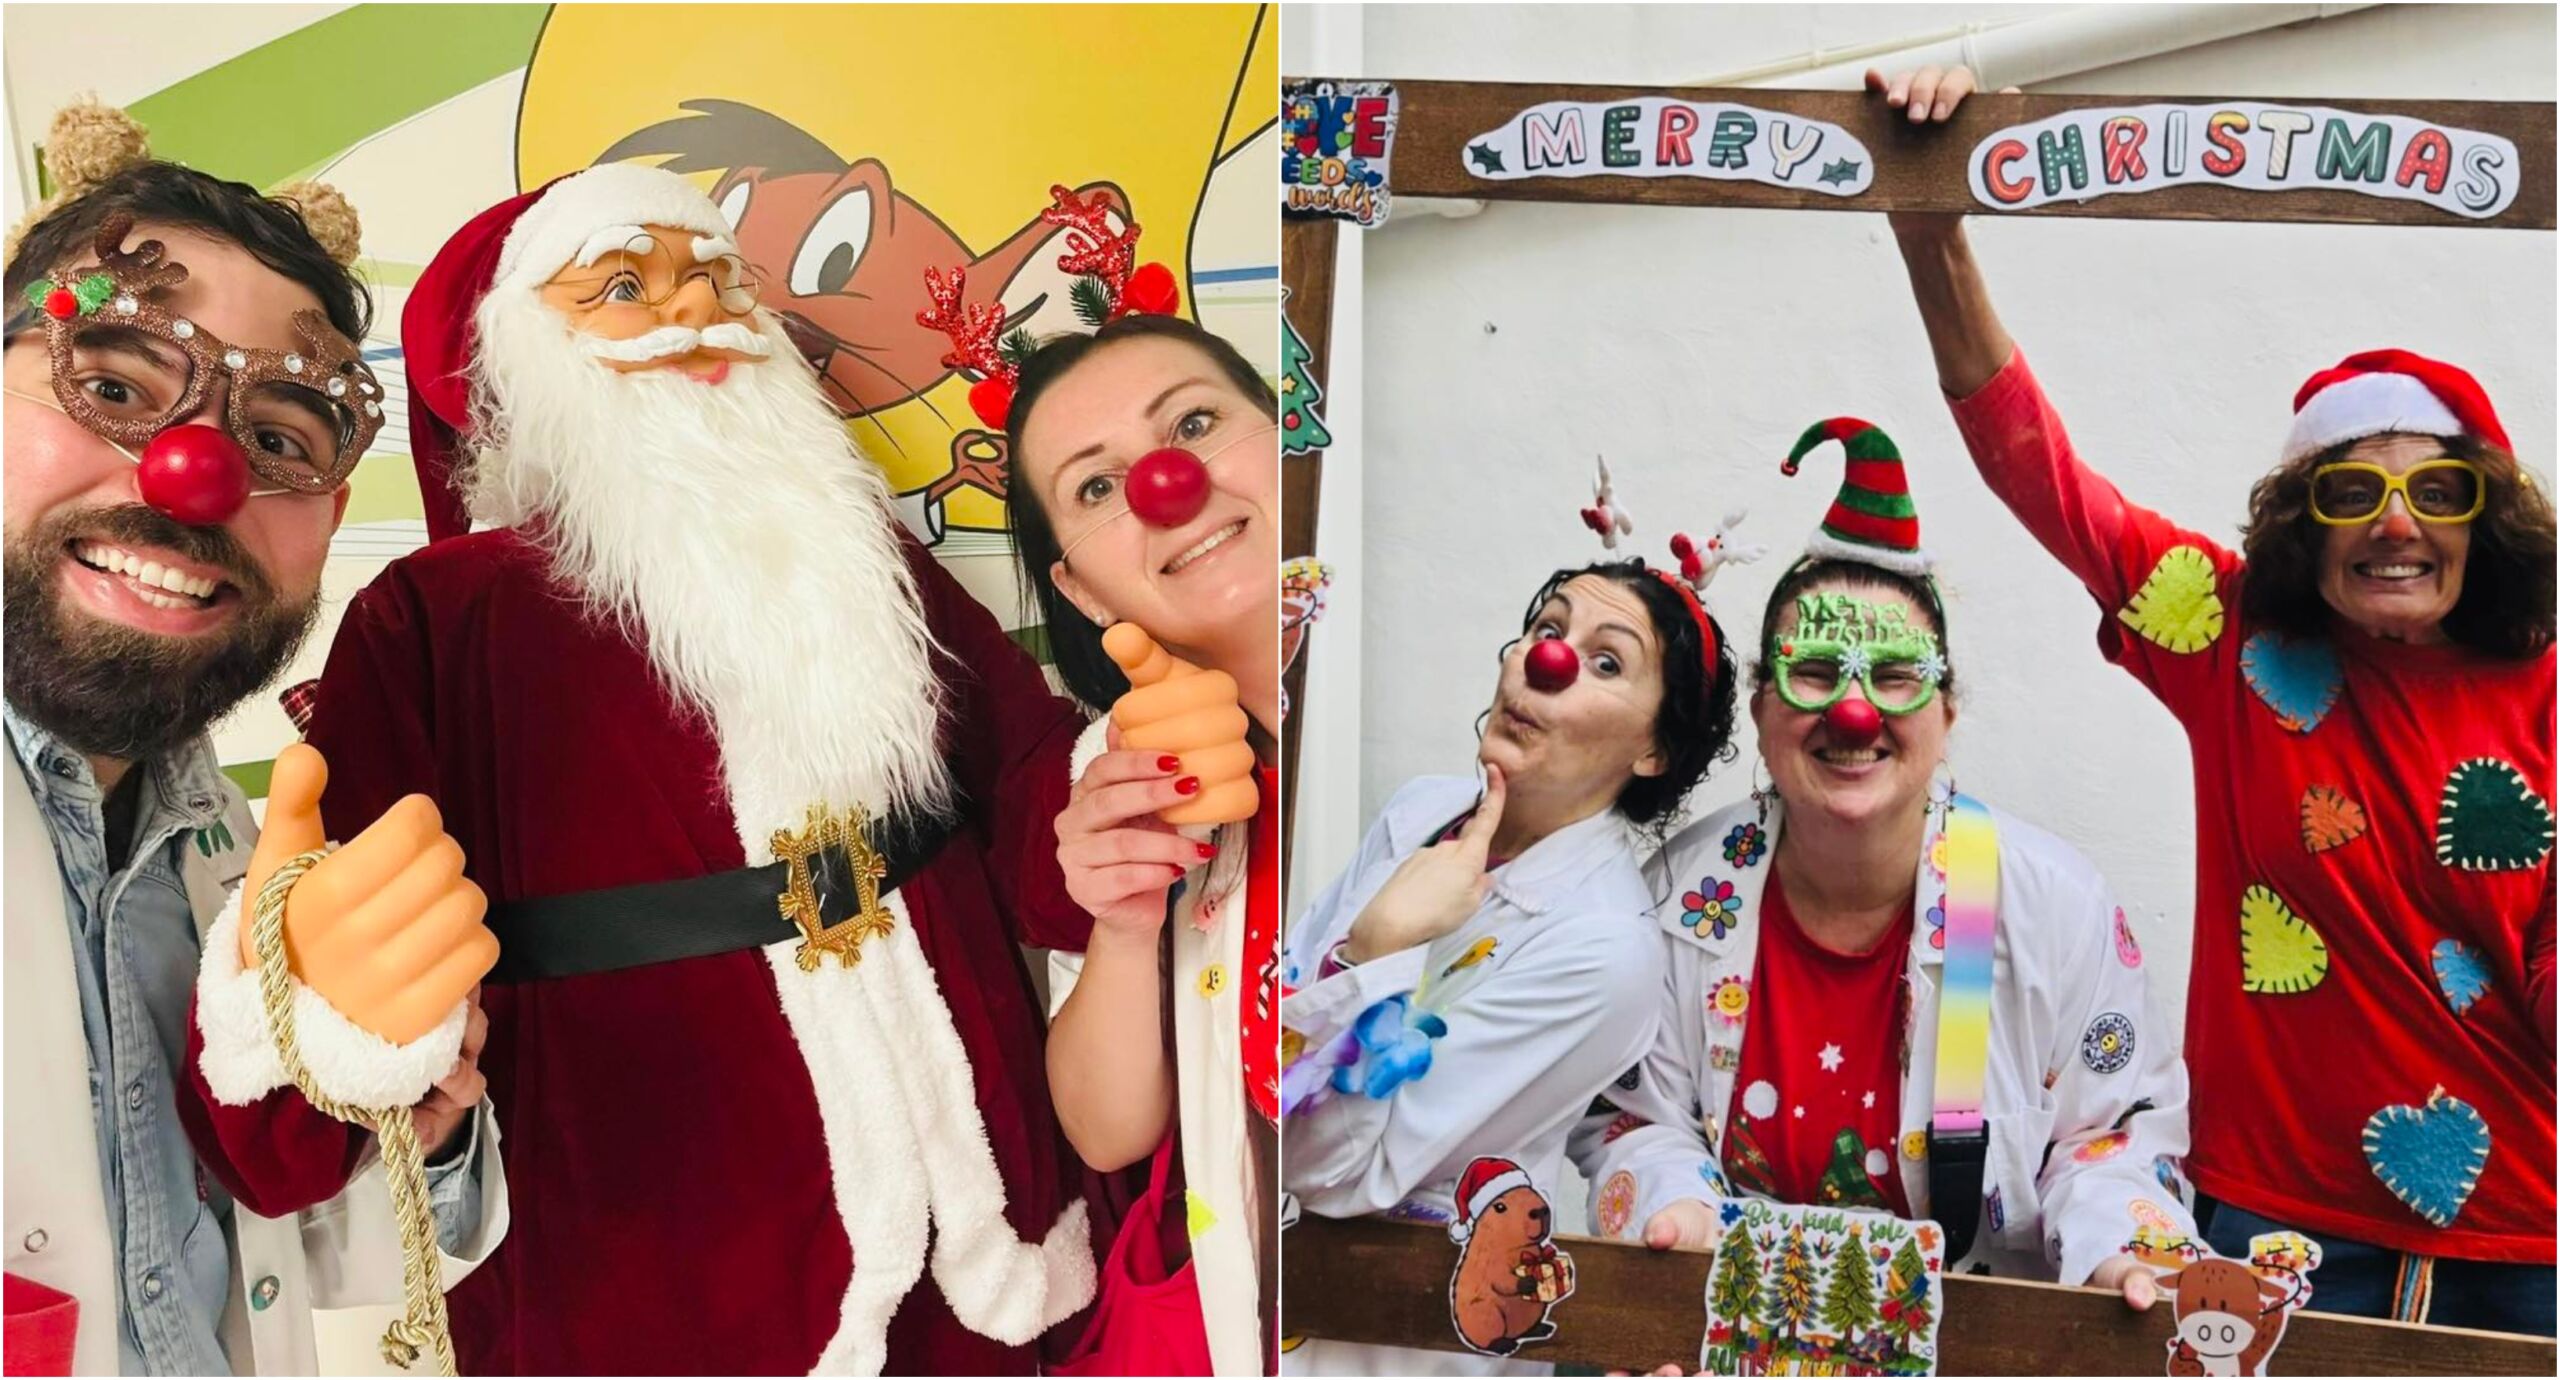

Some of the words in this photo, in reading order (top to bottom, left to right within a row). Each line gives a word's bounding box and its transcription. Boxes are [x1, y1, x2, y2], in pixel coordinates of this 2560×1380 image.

[1282, 157, 1367, 187] EEDS
[1522, 104, 1825, 180] MERRY
[1981, 110, 2503, 213] CHRISTMAS
[1289, 182, 1374, 220] words
[1744, 1200, 1775, 1228] Be
[1779, 1212, 1792, 1230] a
[1801, 1208, 1850, 1236] kind
